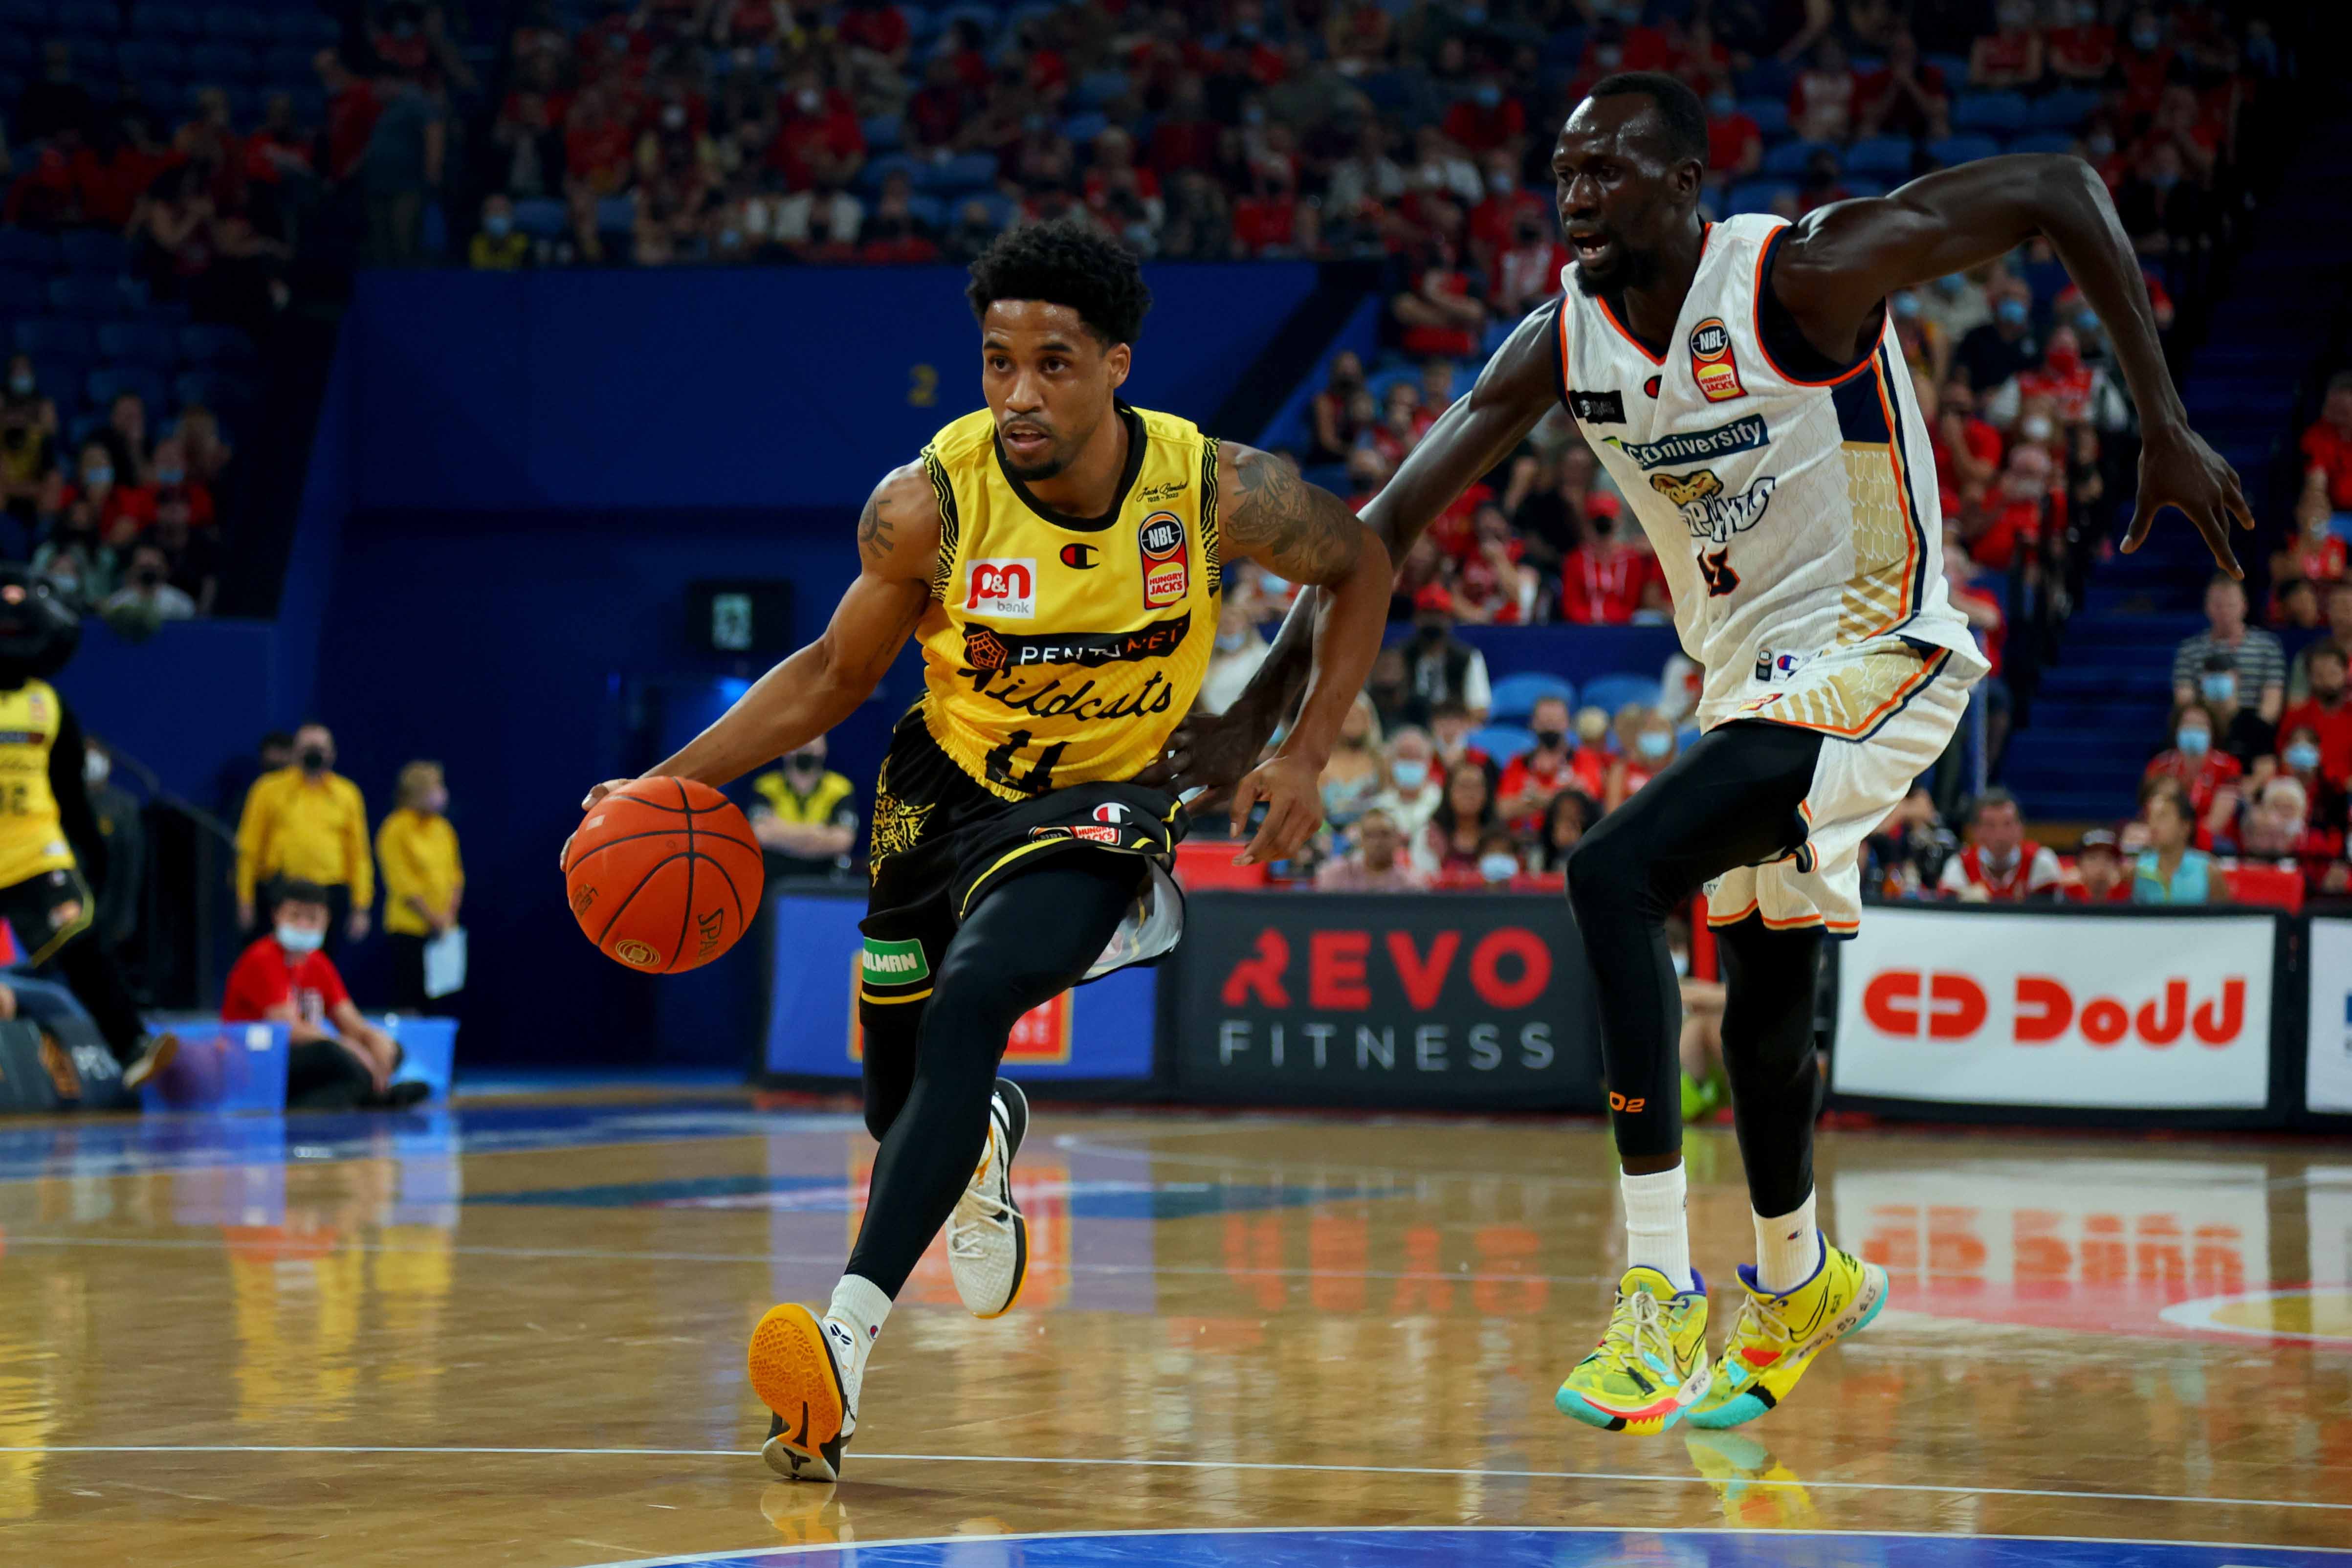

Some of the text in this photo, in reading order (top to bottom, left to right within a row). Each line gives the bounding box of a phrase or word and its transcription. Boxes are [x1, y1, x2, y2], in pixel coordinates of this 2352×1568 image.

[1699, 329, 1723, 351] NBL
[1701, 373, 1731, 384] HUNGRY
[1148, 525, 1174, 549] NBL
[967, 563, 1031, 609] p&n
[1149, 572, 1183, 585] HUNGRY
[996, 600, 1029, 614] bank
[1221, 926, 1553, 1011] REVO
[2013, 975, 2246, 1047] Dodd
[1218, 1020, 1555, 1071] FITNESS
